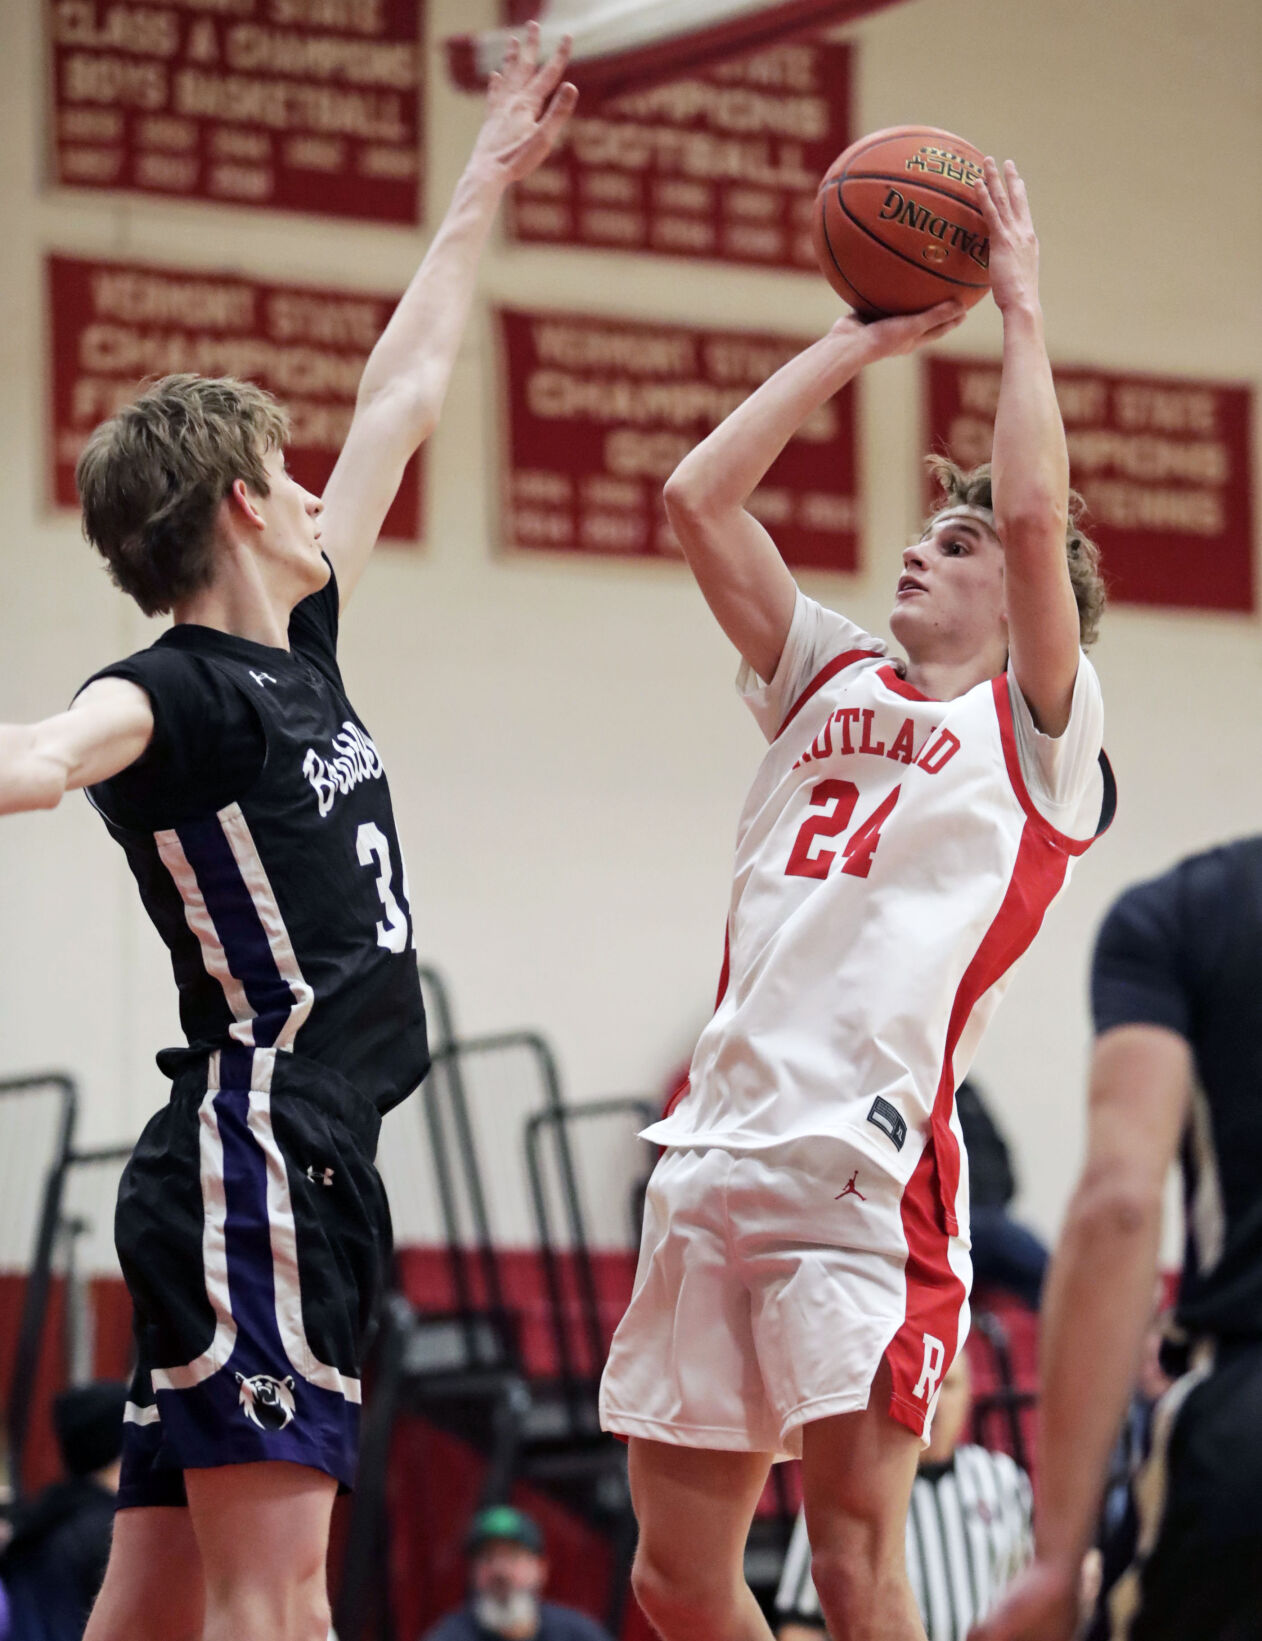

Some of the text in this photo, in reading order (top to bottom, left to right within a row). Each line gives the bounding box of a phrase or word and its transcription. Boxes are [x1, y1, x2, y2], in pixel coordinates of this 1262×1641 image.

[878, 187, 991, 272] PALDING
[784, 779, 902, 880] 24
[912, 1333, 945, 1404] R
